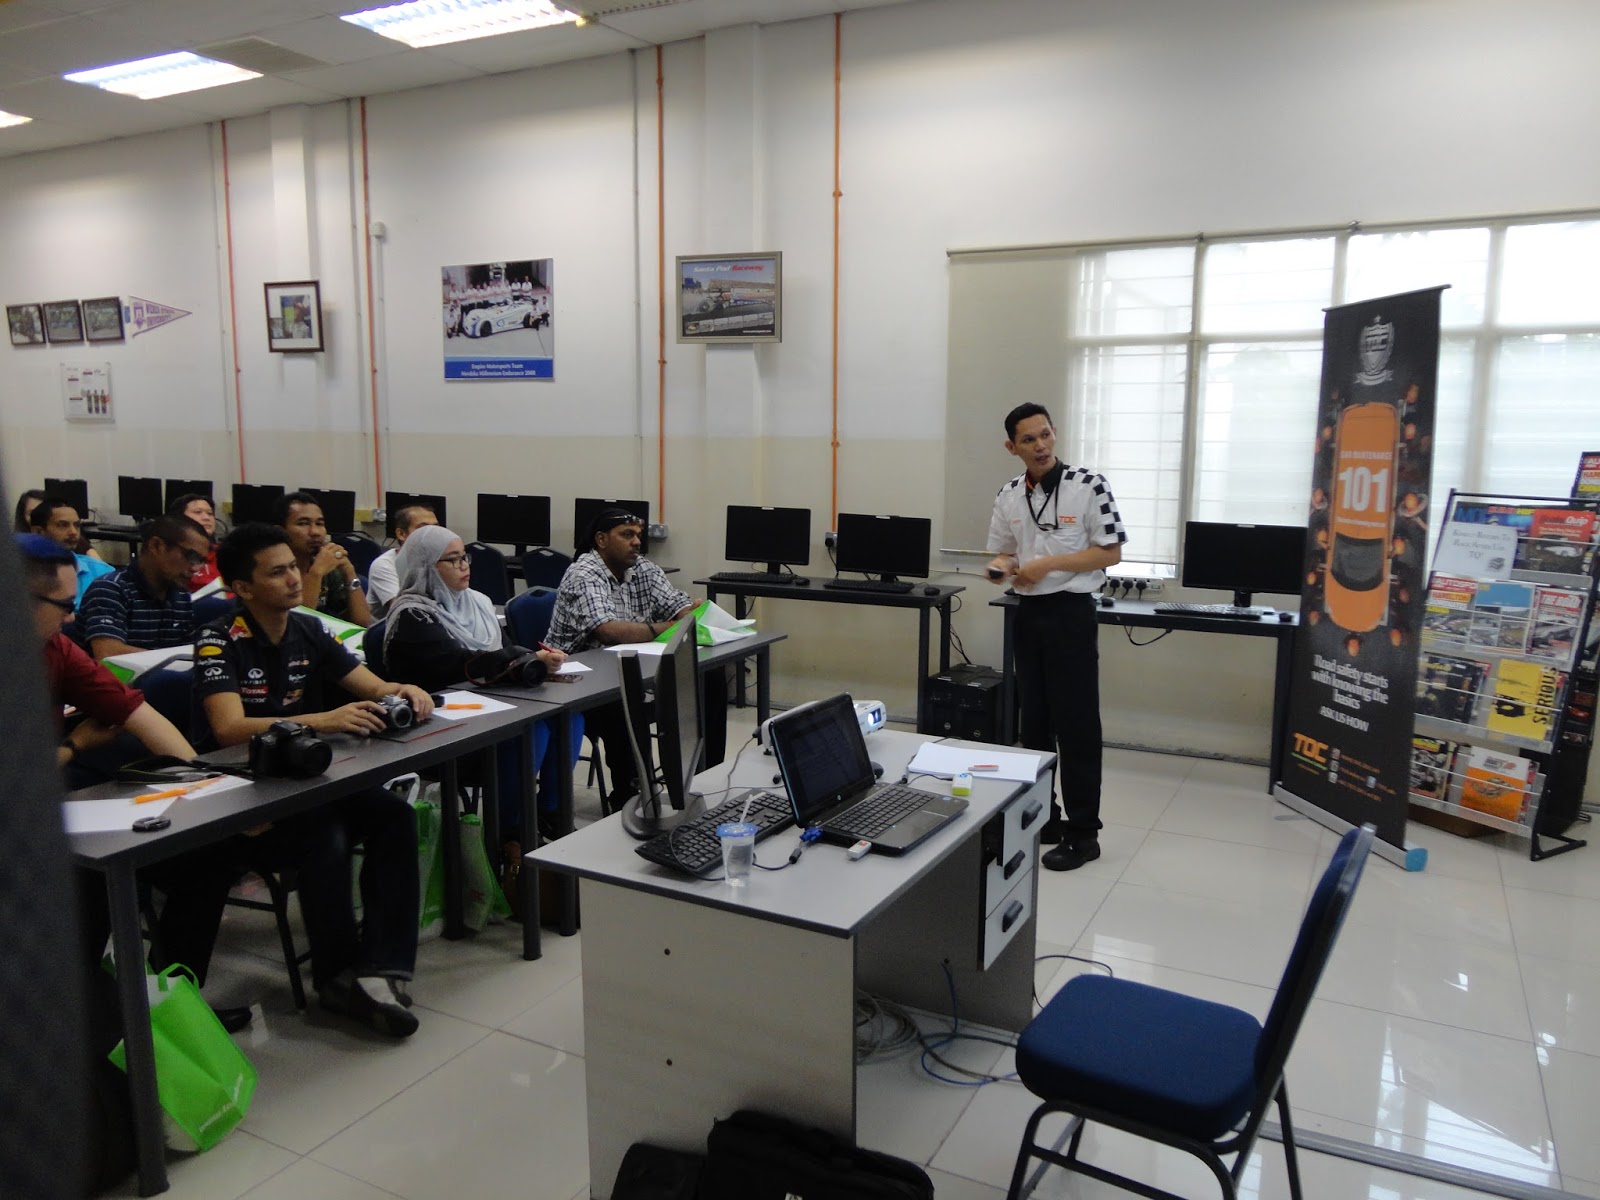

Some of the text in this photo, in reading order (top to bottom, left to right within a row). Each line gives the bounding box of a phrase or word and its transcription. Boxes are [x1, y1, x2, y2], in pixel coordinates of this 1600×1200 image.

[1338, 466, 1388, 512] 101
[1311, 669, 1389, 704] with knowing the
[1313, 654, 1389, 689] Road safety starts
[1332, 688, 1361, 710] basics
[1345, 715, 1370, 732] HOW
[1293, 732, 1329, 764] TOC
